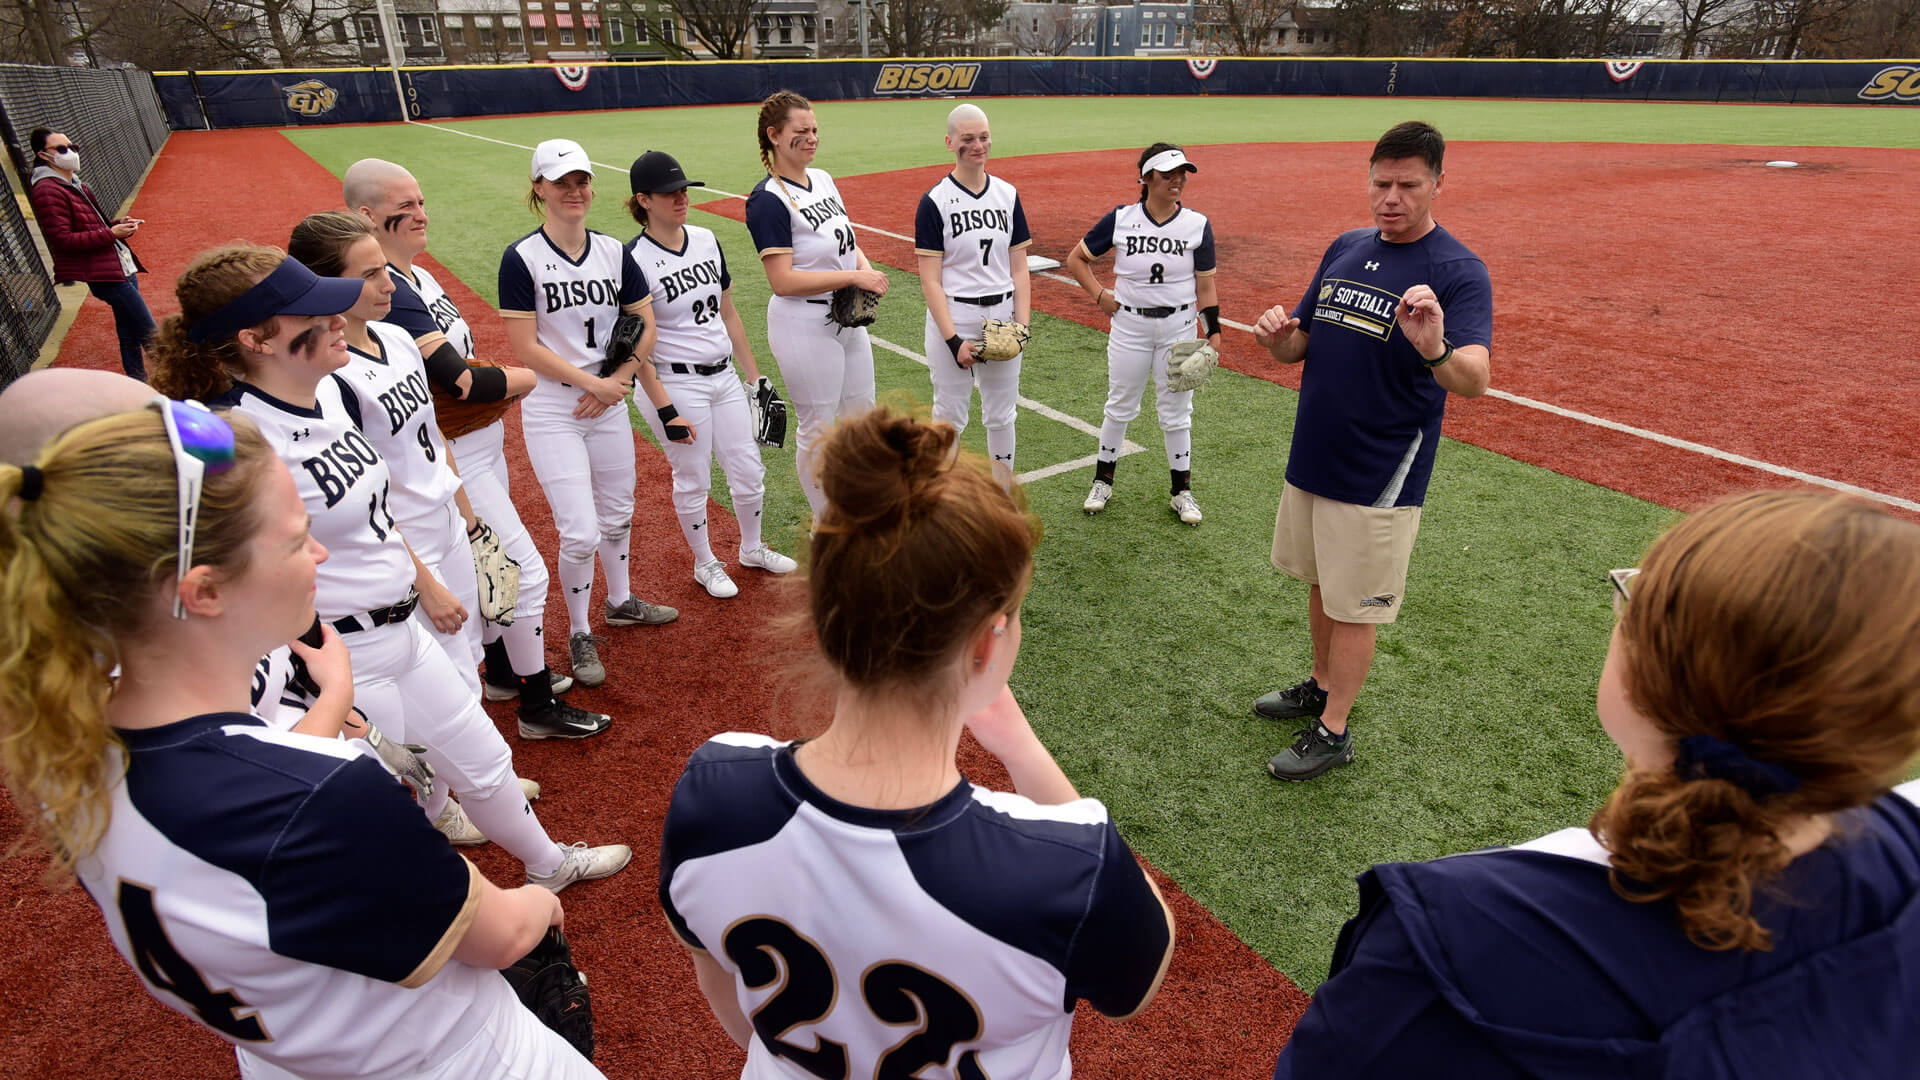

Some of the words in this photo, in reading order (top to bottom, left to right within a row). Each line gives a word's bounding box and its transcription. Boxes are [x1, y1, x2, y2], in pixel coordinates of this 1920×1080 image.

[404, 72, 421, 117] 190
[875, 65, 980, 92] BISON
[1387, 61, 1398, 95] 220
[800, 195, 847, 232] BISON
[950, 208, 1009, 239] BISON
[834, 224, 856, 257] 24
[979, 238, 993, 266] 7
[1125, 235, 1189, 257] BISON
[659, 259, 721, 304] BISON
[1149, 262, 1165, 284] 8
[542, 278, 620, 314] BISON
[691, 294, 719, 325] 23
[1333, 286, 1393, 319] SOFTBALL
[584, 316, 597, 349] 1
[377, 369, 433, 437] BISO
[417, 421, 436, 463] 9
[301, 425, 384, 511] BISO
[368, 479, 395, 543] 11
[116, 876, 274, 1043] 4
[721, 913, 991, 1080] 22
